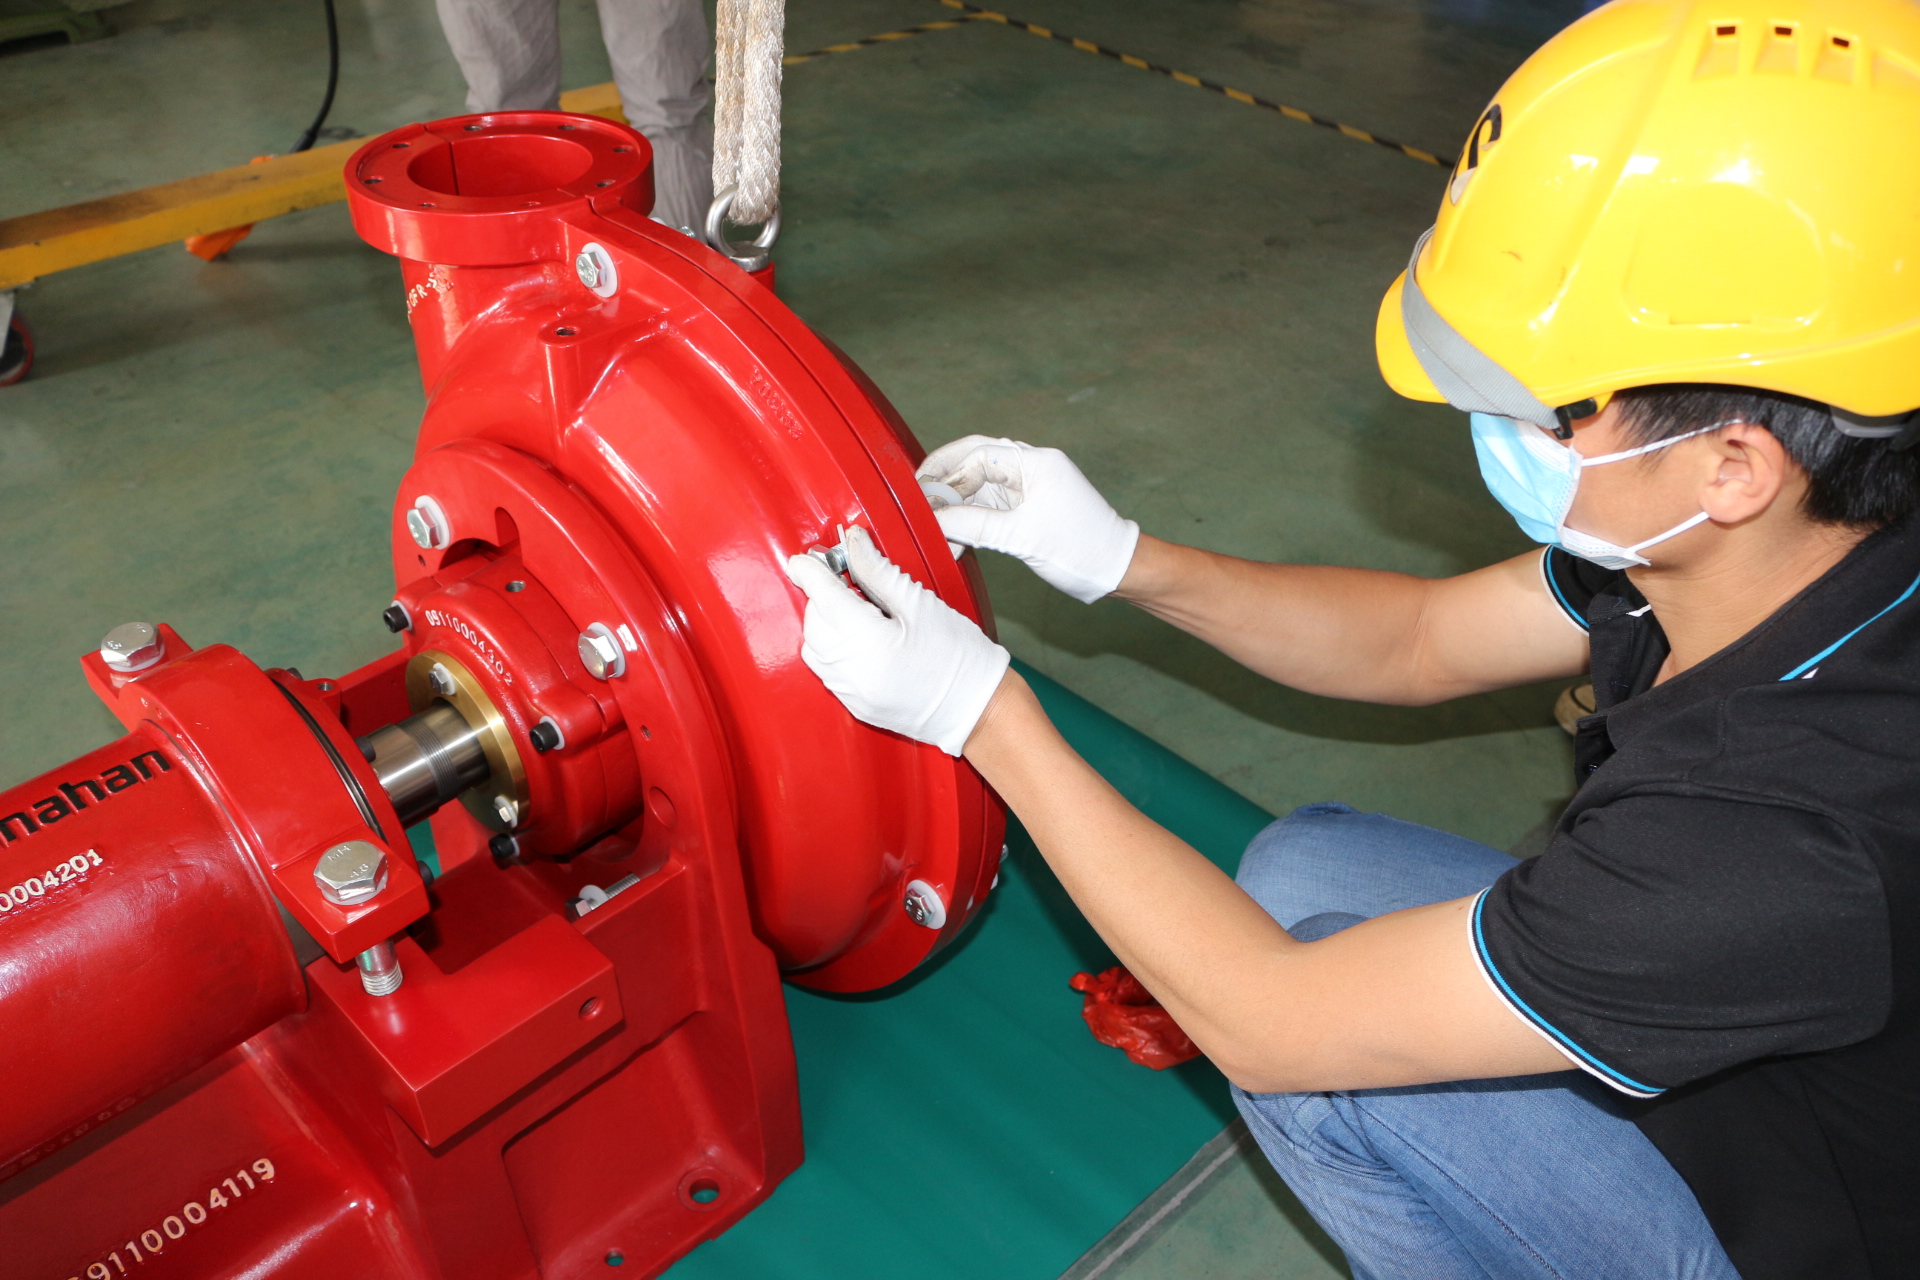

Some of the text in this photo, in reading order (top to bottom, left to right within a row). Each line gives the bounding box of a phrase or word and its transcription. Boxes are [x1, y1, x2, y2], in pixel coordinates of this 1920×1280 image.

[425, 609, 513, 686] 09110004302
[0, 750, 171, 842] nahan
[0, 848, 104, 912] 0004201
[67, 1158, 275, 1280] 9110004119
